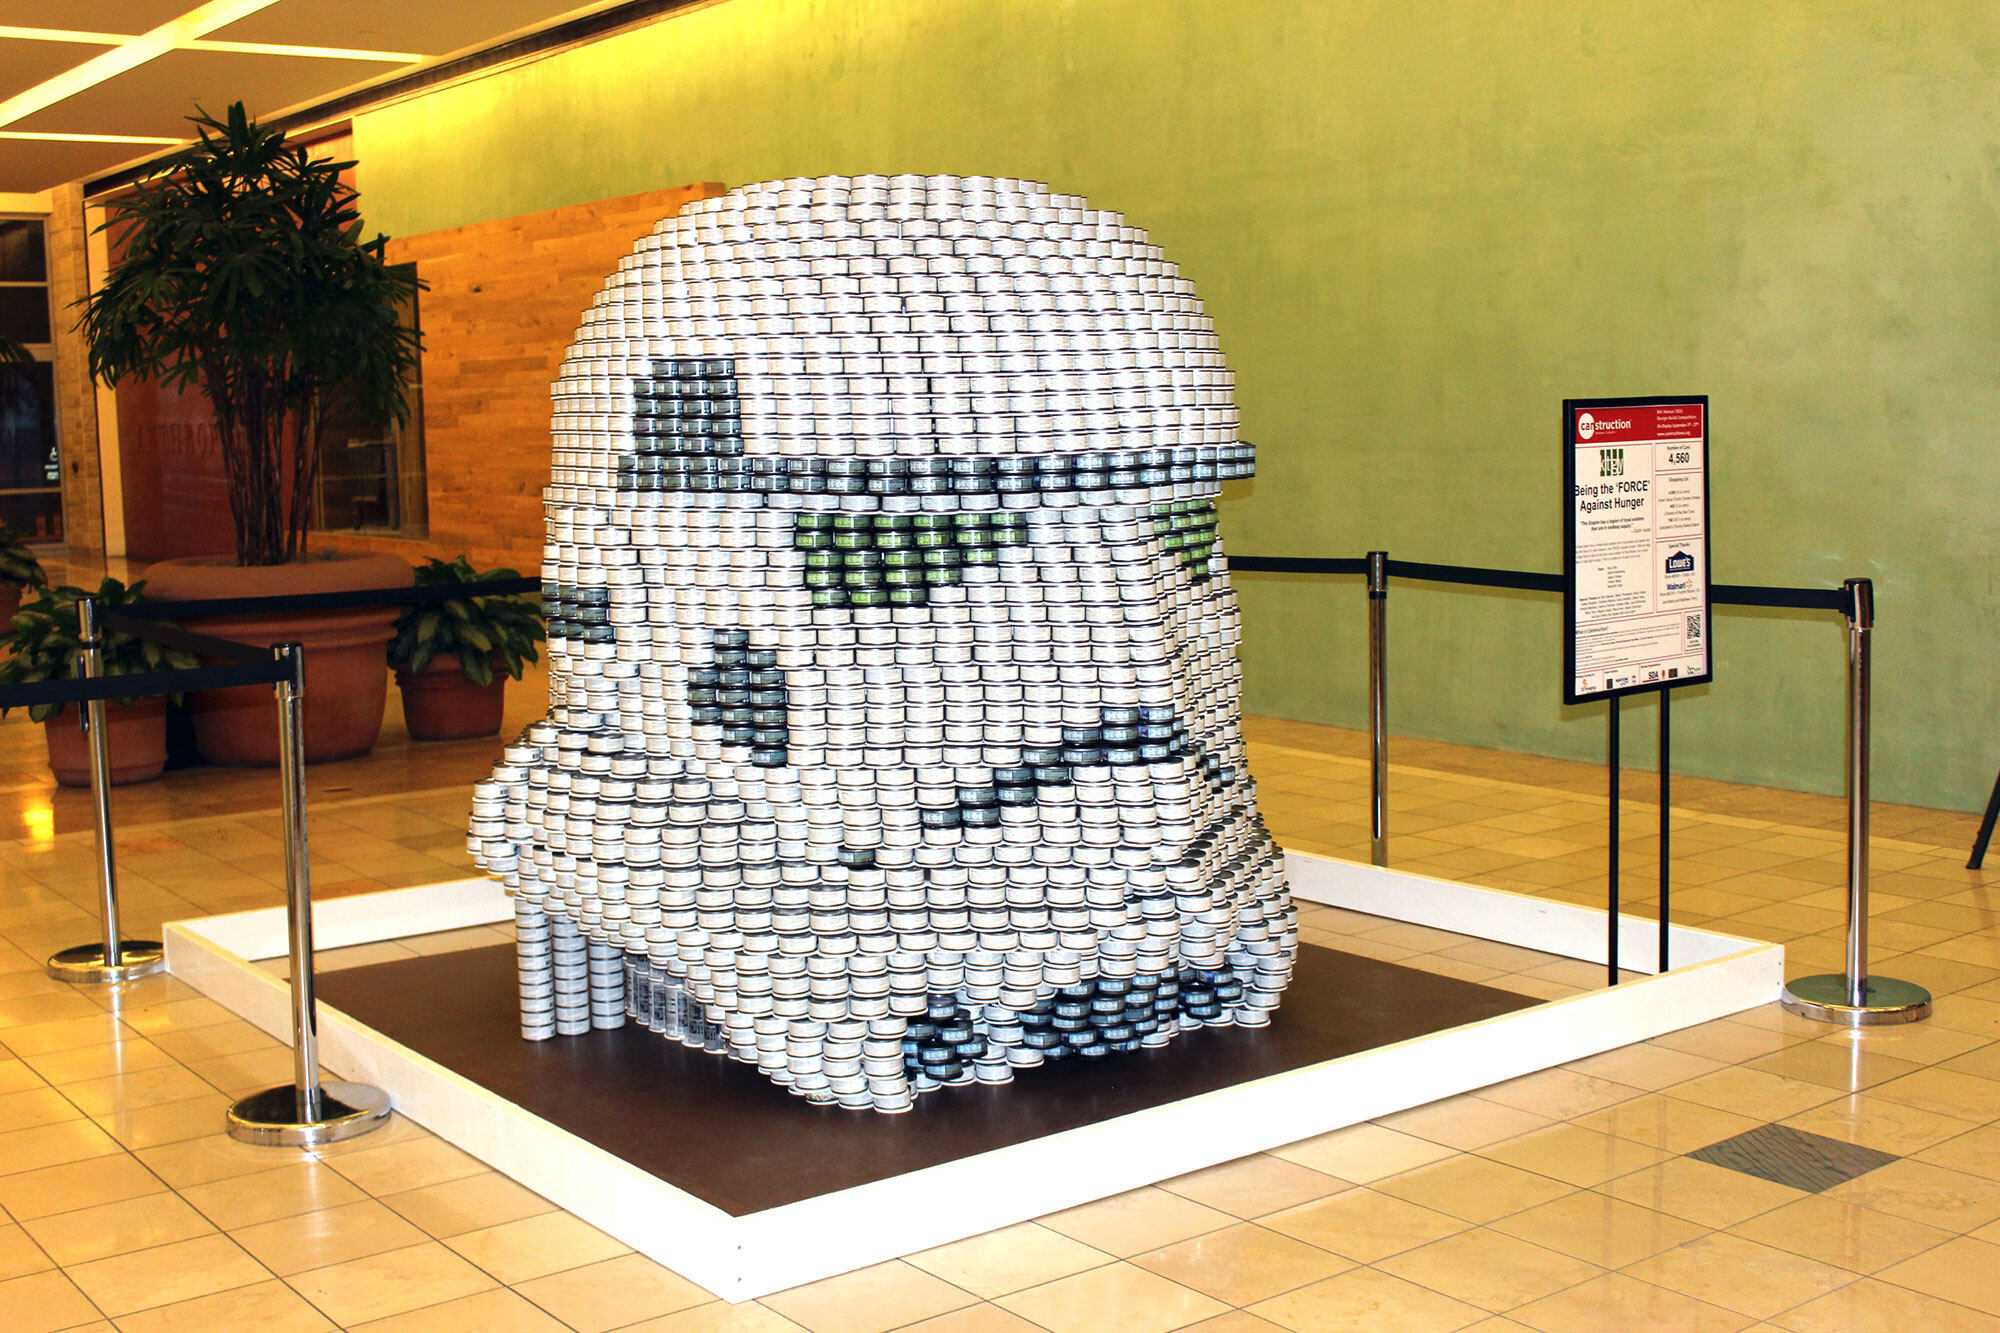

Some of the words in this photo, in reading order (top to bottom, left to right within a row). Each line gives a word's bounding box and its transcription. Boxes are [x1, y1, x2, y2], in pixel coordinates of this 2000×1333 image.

[1668, 452, 1690, 465] 4,560
[1575, 485, 1598, 498] Being
[1600, 483, 1614, 493] the
[1580, 499, 1612, 513] Against
[1614, 497, 1645, 510] Hunger
[1669, 558, 1691, 568] LOWE'S
